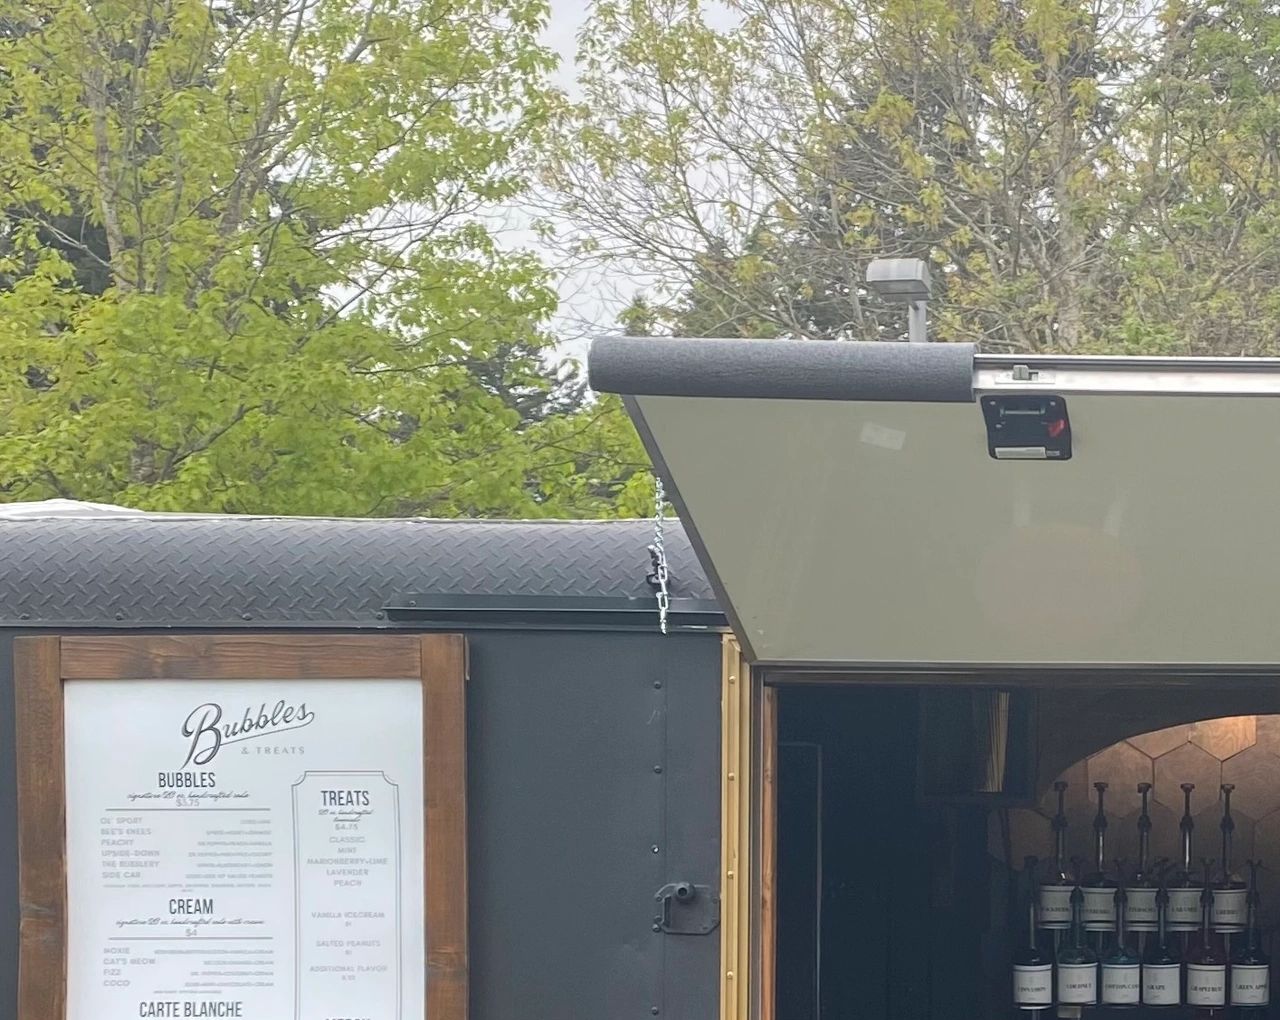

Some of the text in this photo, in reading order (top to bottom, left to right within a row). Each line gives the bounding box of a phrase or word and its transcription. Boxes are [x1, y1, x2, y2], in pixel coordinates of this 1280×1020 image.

[181, 699, 315, 770] Bubbles
[256, 746, 305, 755] TREATS
[158, 772, 216, 788] BUBBLES
[321, 790, 370, 807] TREATS
[169, 899, 214, 914] CREAM
[139, 1001, 243, 1017] CARTE BLANCHE
